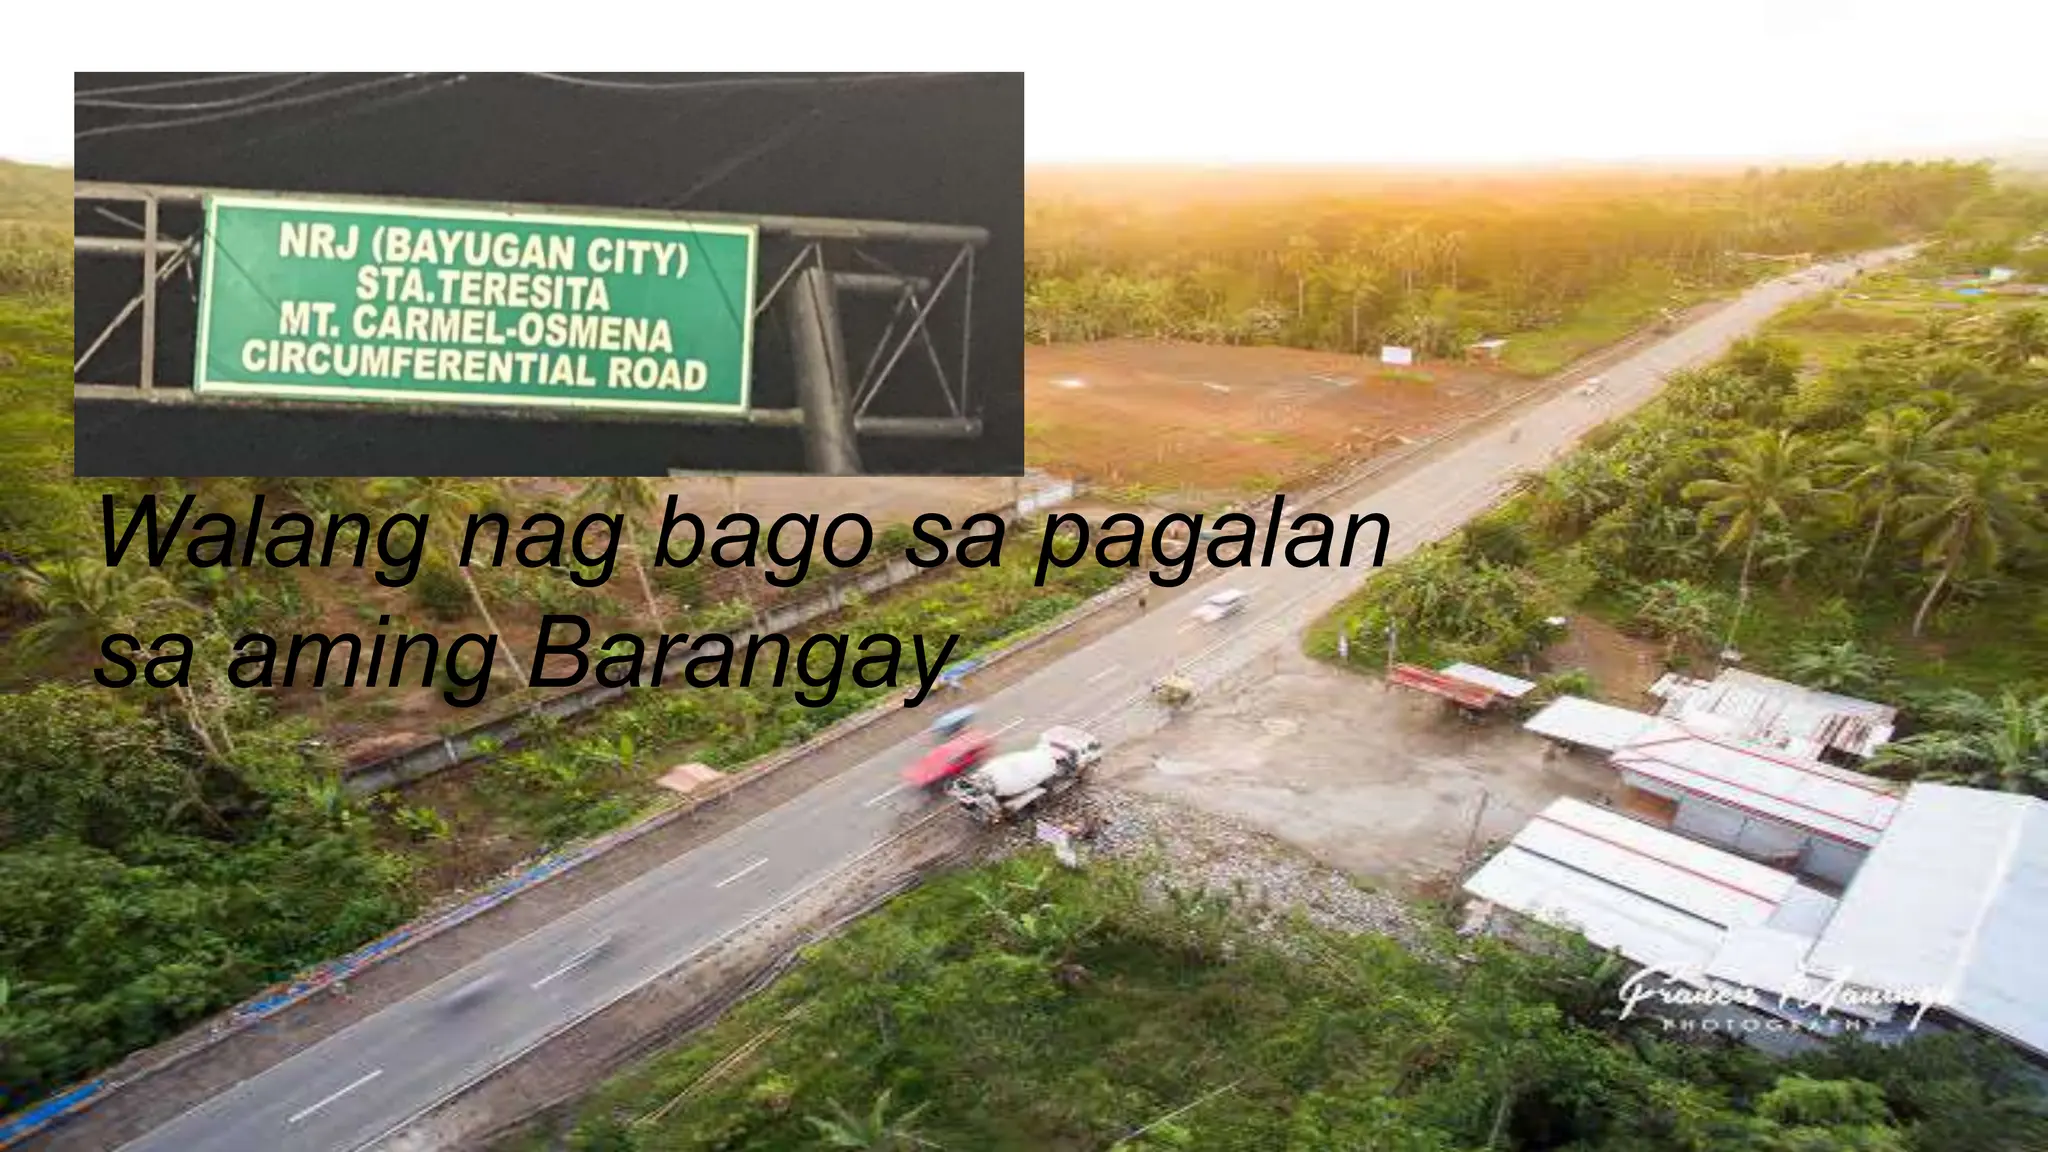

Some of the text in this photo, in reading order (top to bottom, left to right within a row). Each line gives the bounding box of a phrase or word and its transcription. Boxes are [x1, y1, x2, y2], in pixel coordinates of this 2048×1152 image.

[279, 222, 689, 278] NRJ (BAYUGAN CITY)
[356, 266, 610, 311] STA.TERESITA
[279, 301, 673, 353] MT. CARMEL-OSMENA
[241, 339, 708, 391] CIRCUMFERENTIAL ROAD
